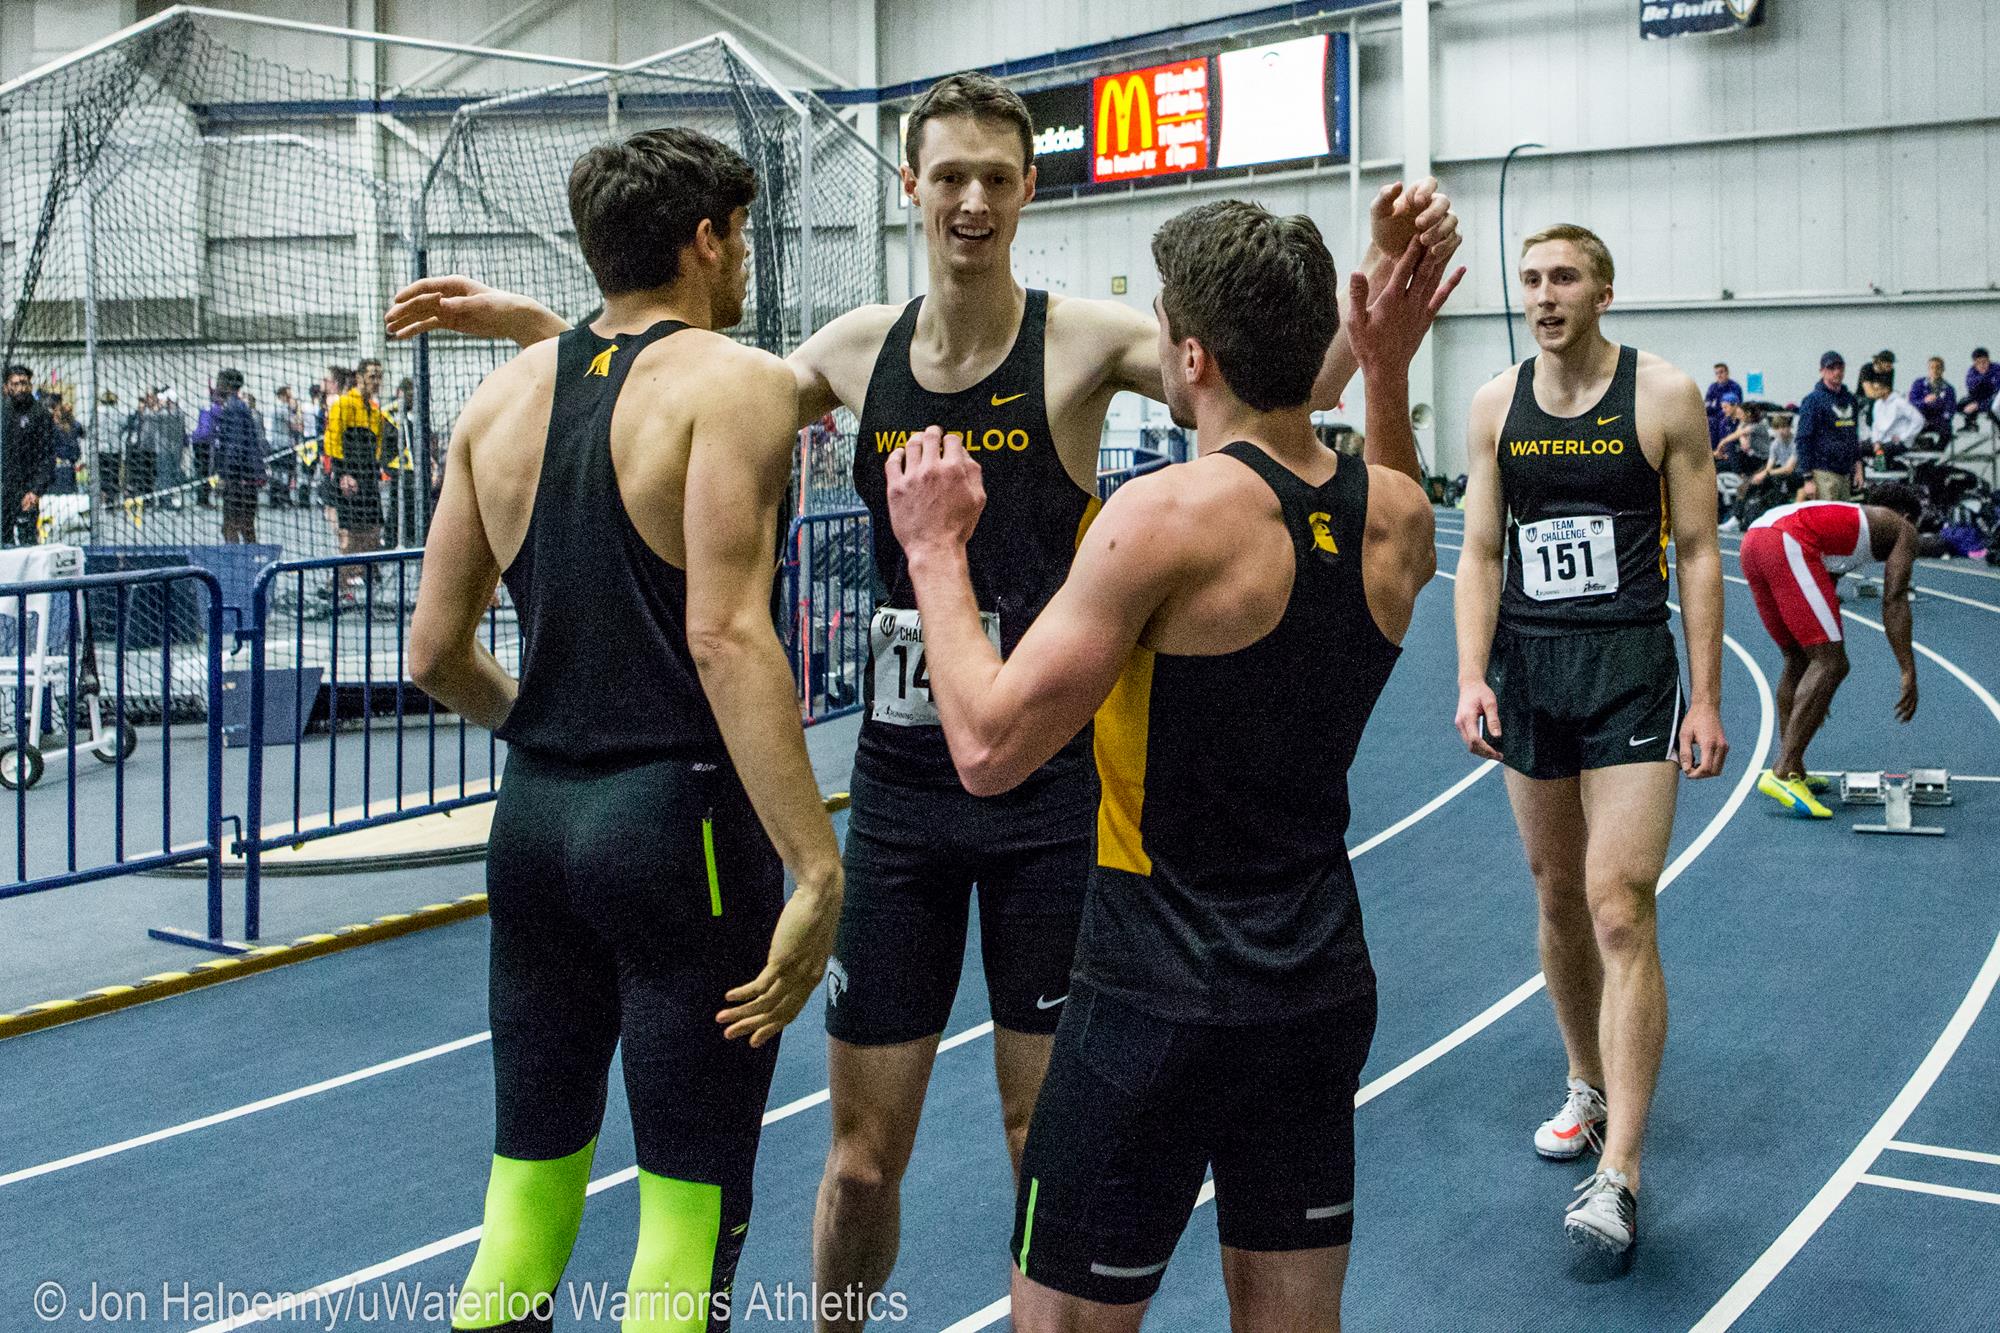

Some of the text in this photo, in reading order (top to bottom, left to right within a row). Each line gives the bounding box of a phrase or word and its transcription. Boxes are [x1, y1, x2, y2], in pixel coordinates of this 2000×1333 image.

[1510, 439, 1624, 456] WATERLOO
[1552, 520, 1574, 531] TEAM
[1541, 529, 1587, 543] CHALLENGE
[1537, 541, 1594, 582] 151
[893, 645, 935, 702] 14
